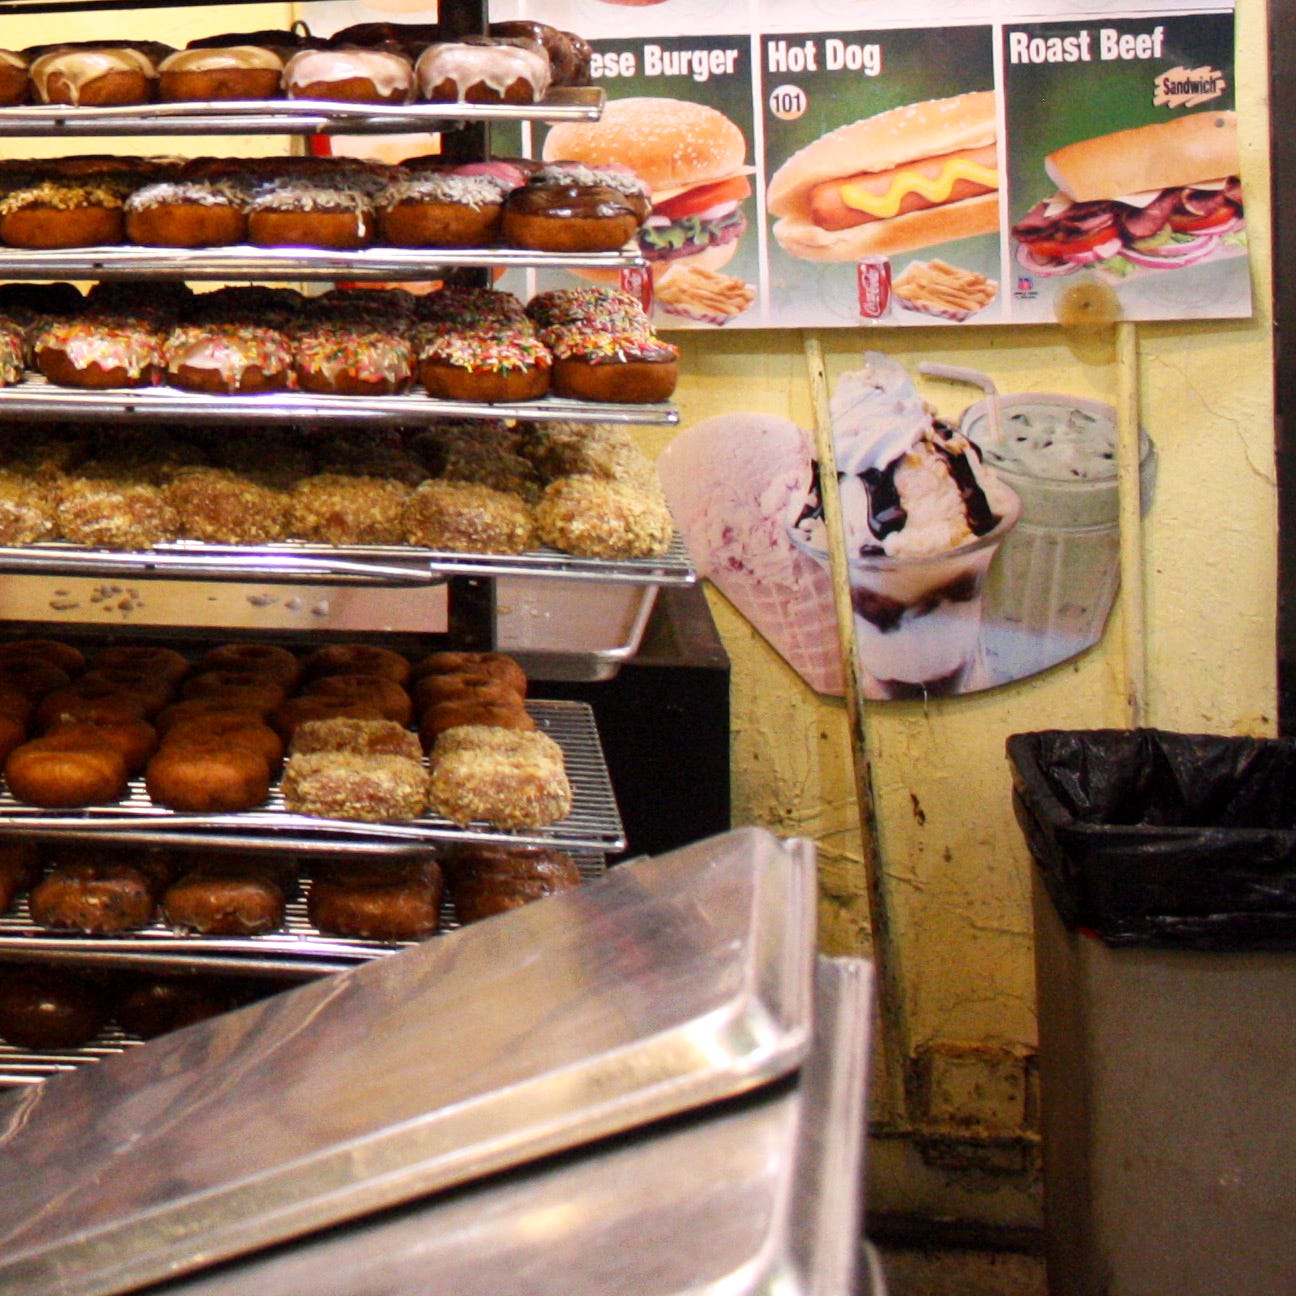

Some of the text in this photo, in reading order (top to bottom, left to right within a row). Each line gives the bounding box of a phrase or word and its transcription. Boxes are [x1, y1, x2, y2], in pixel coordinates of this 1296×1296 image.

[643, 44, 739, 82] Burger
[767, 38, 882, 77] Hot Dog
[1009, 25, 1166, 65] Roast Beef
[772, 92, 802, 114] 101
[1162, 76, 1217, 96] Sandwich
